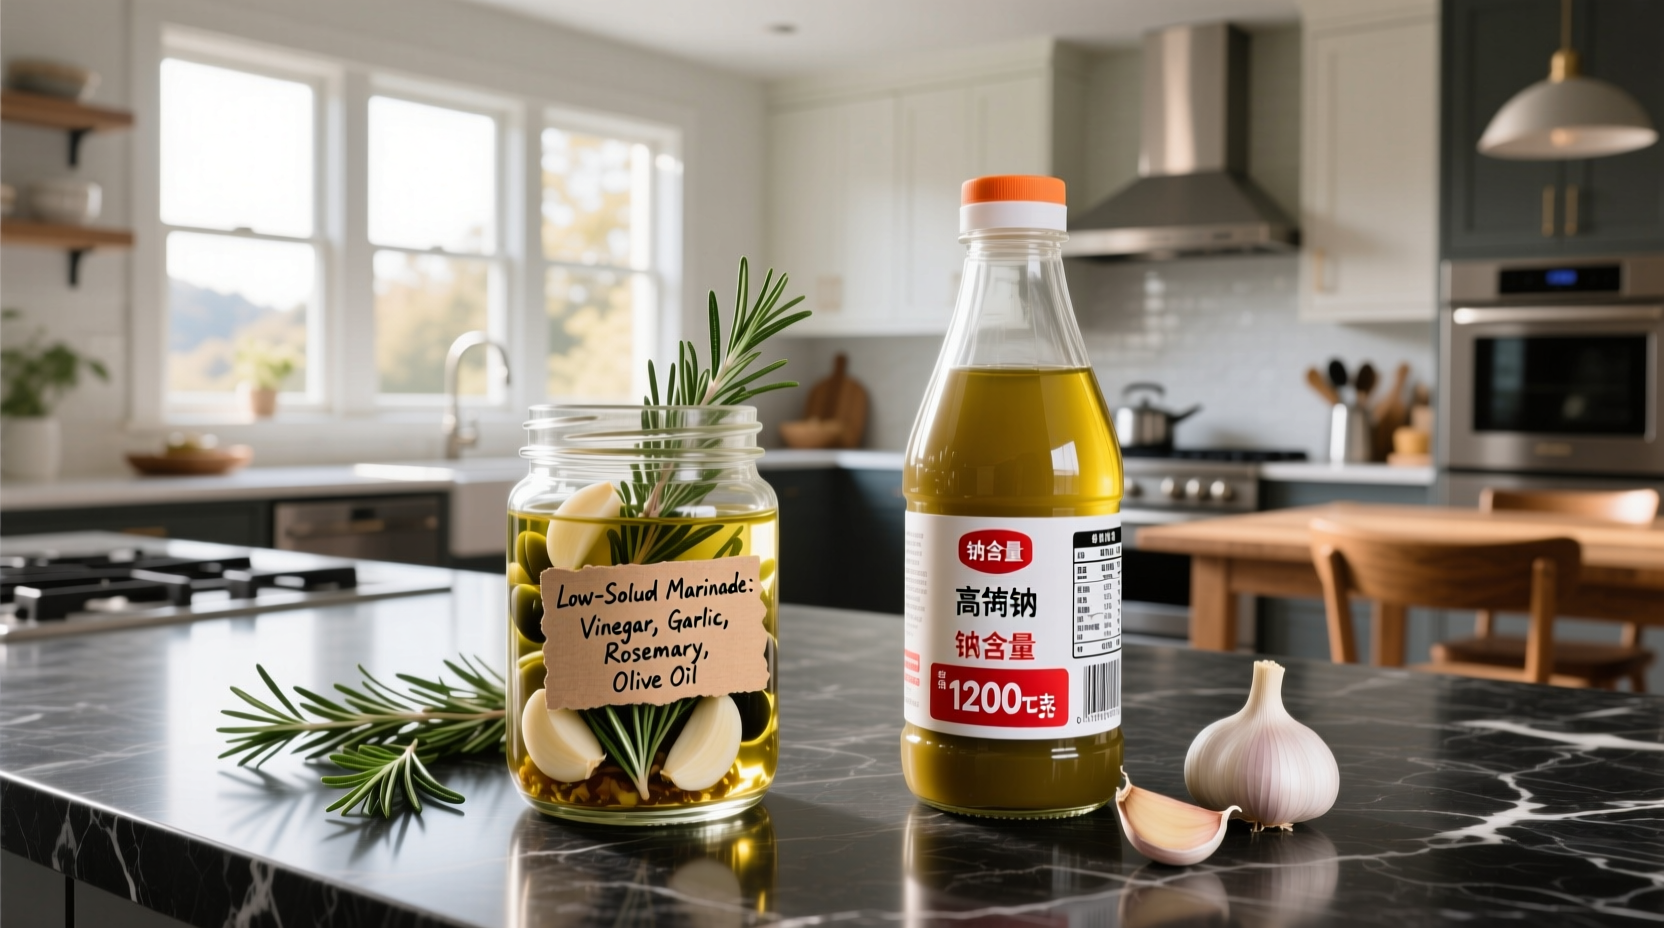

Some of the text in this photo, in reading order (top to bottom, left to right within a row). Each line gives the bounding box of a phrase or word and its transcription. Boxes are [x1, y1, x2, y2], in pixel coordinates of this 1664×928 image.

[967, 540, 1024, 562] 钠含量
[556, 571, 754, 608] Low-Solud Marinade:
[580, 607, 729, 644] Vinegar, Garlic,
[604, 642, 709, 664] Rosemary,
[955, 630, 1036, 660] 钠含量
[613, 665, 697, 692] Olive Oil
